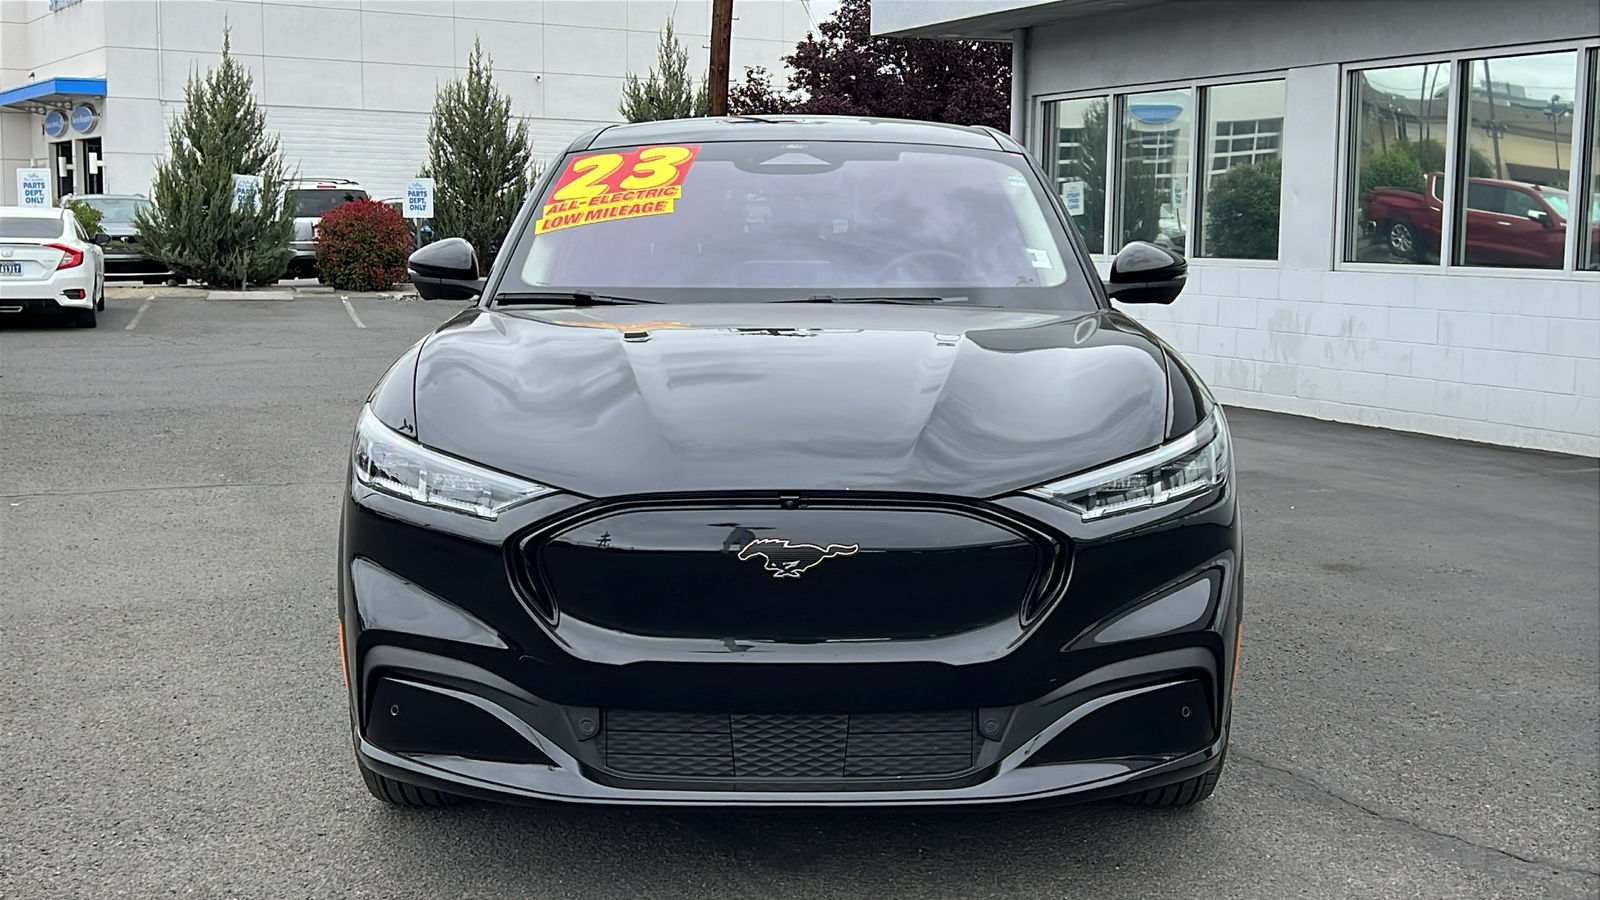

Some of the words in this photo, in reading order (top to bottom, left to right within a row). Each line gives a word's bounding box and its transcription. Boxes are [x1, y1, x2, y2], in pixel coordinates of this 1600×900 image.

[553, 147, 693, 200] 23
[541, 212, 585, 231] LOW
[584, 201, 668, 222] MILEAGE
[545, 187, 679, 215] ALL-ELECTRIC
